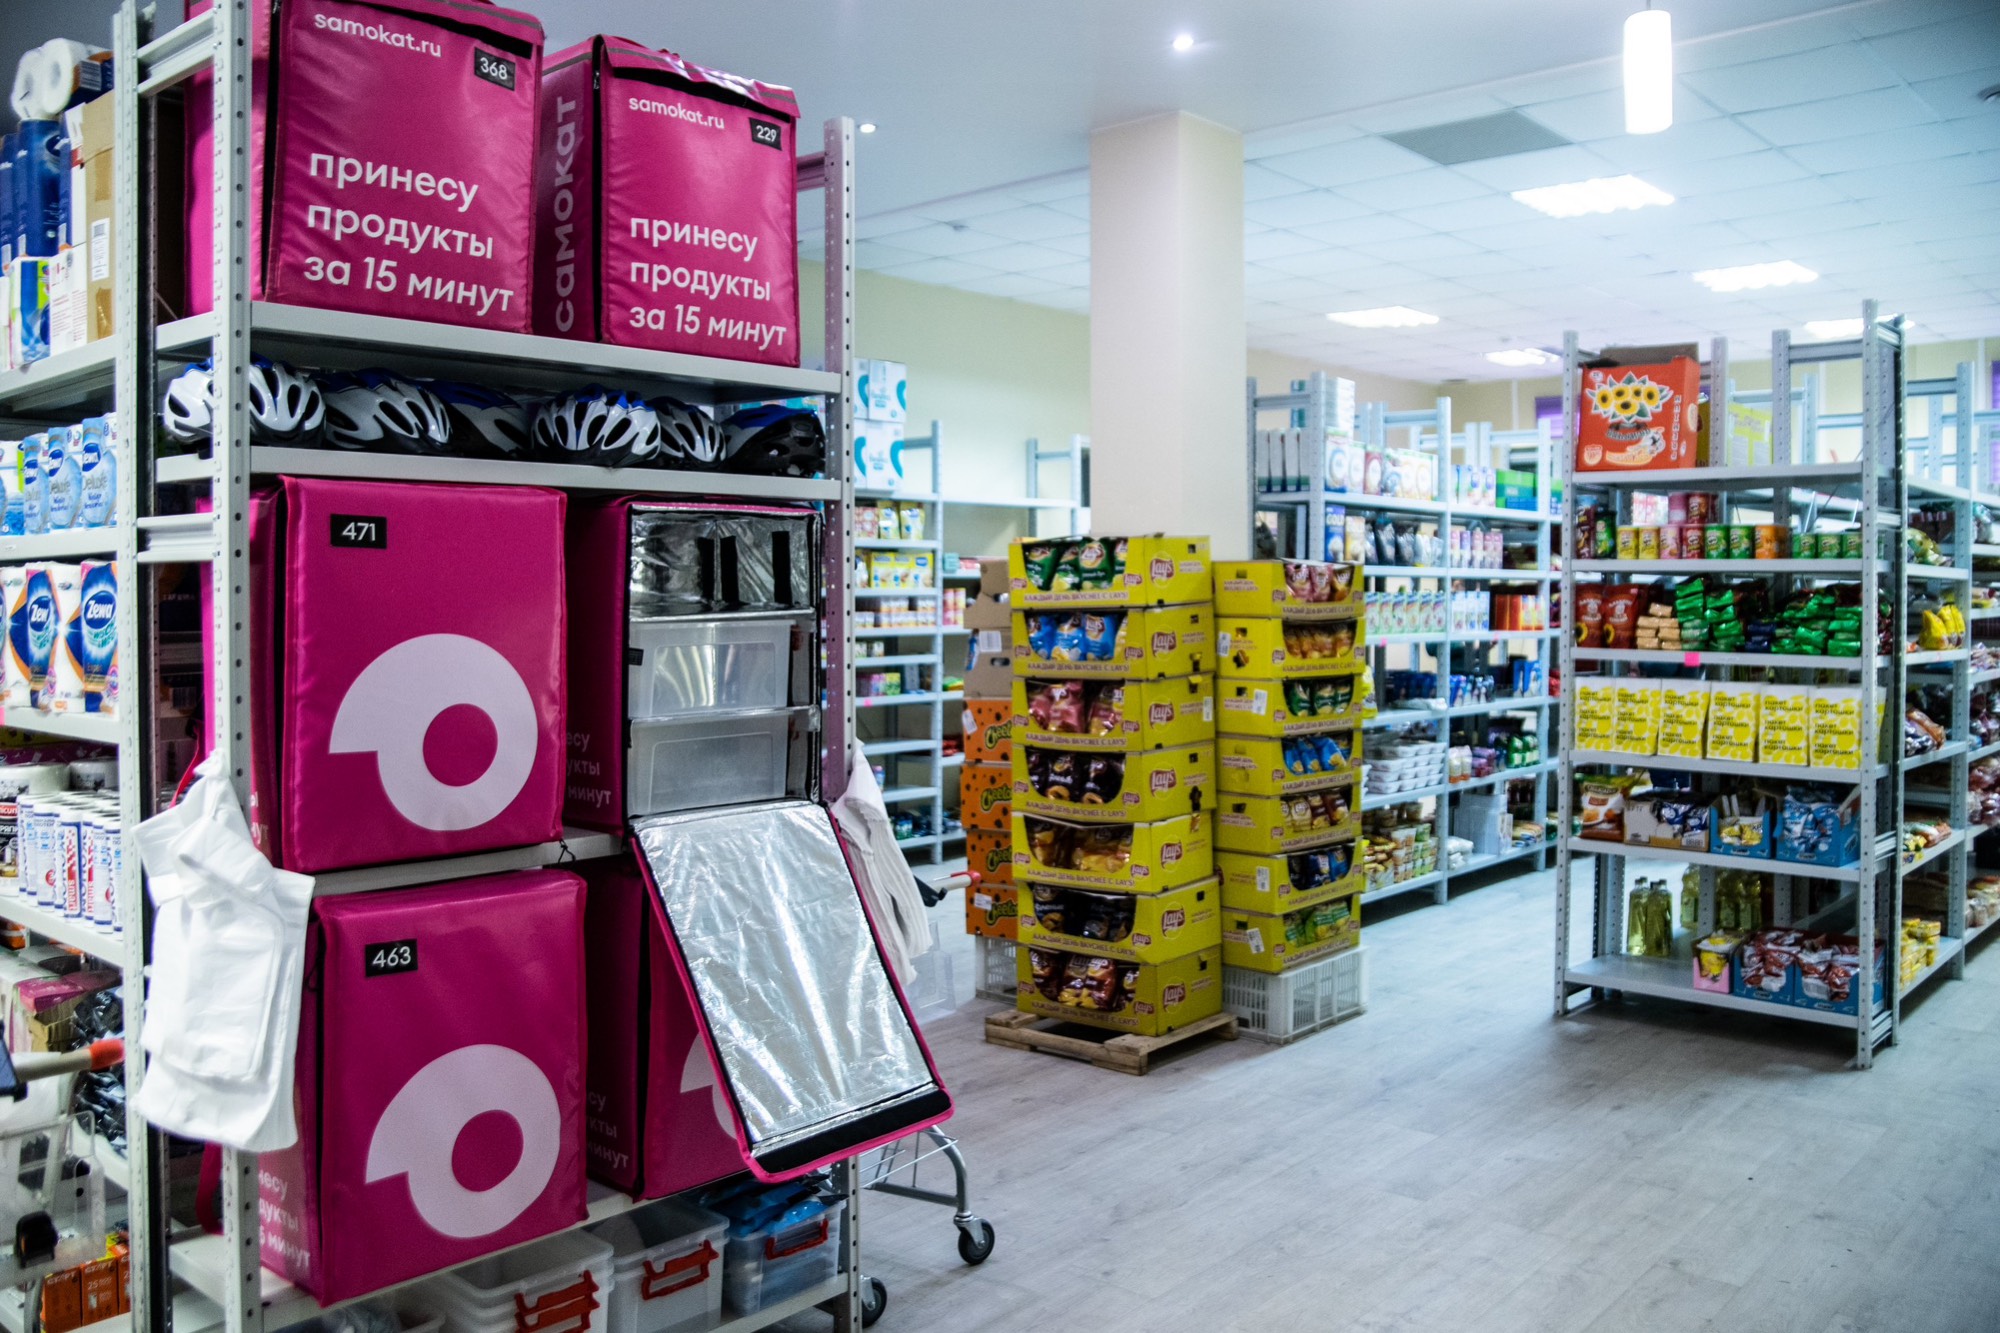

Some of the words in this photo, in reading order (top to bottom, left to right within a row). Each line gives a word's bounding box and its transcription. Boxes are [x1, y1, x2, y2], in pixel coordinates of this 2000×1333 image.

[314, 13, 441, 57] samokat.ru
[480, 57, 508, 80] 368
[629, 97, 725, 129] samokat.ru
[755, 125, 777, 142] 229
[310, 152, 478, 213] принесу
[307, 204, 493, 260] продукты
[554, 96, 577, 332] самокат
[630, 217, 758, 261] принесу
[303, 256, 351, 285] за
[363, 256, 397, 292] 15
[407, 273, 514, 316] минут
[630, 261, 770, 301] продукты
[629, 306, 665, 329] за
[674, 304, 701, 334] 15
[707, 316, 787, 350] минут
[342, 522, 376, 541] 471
[31, 604, 48, 623] Zew
[86, 599, 114, 619] Zewa
[372, 946, 411, 967] 463
